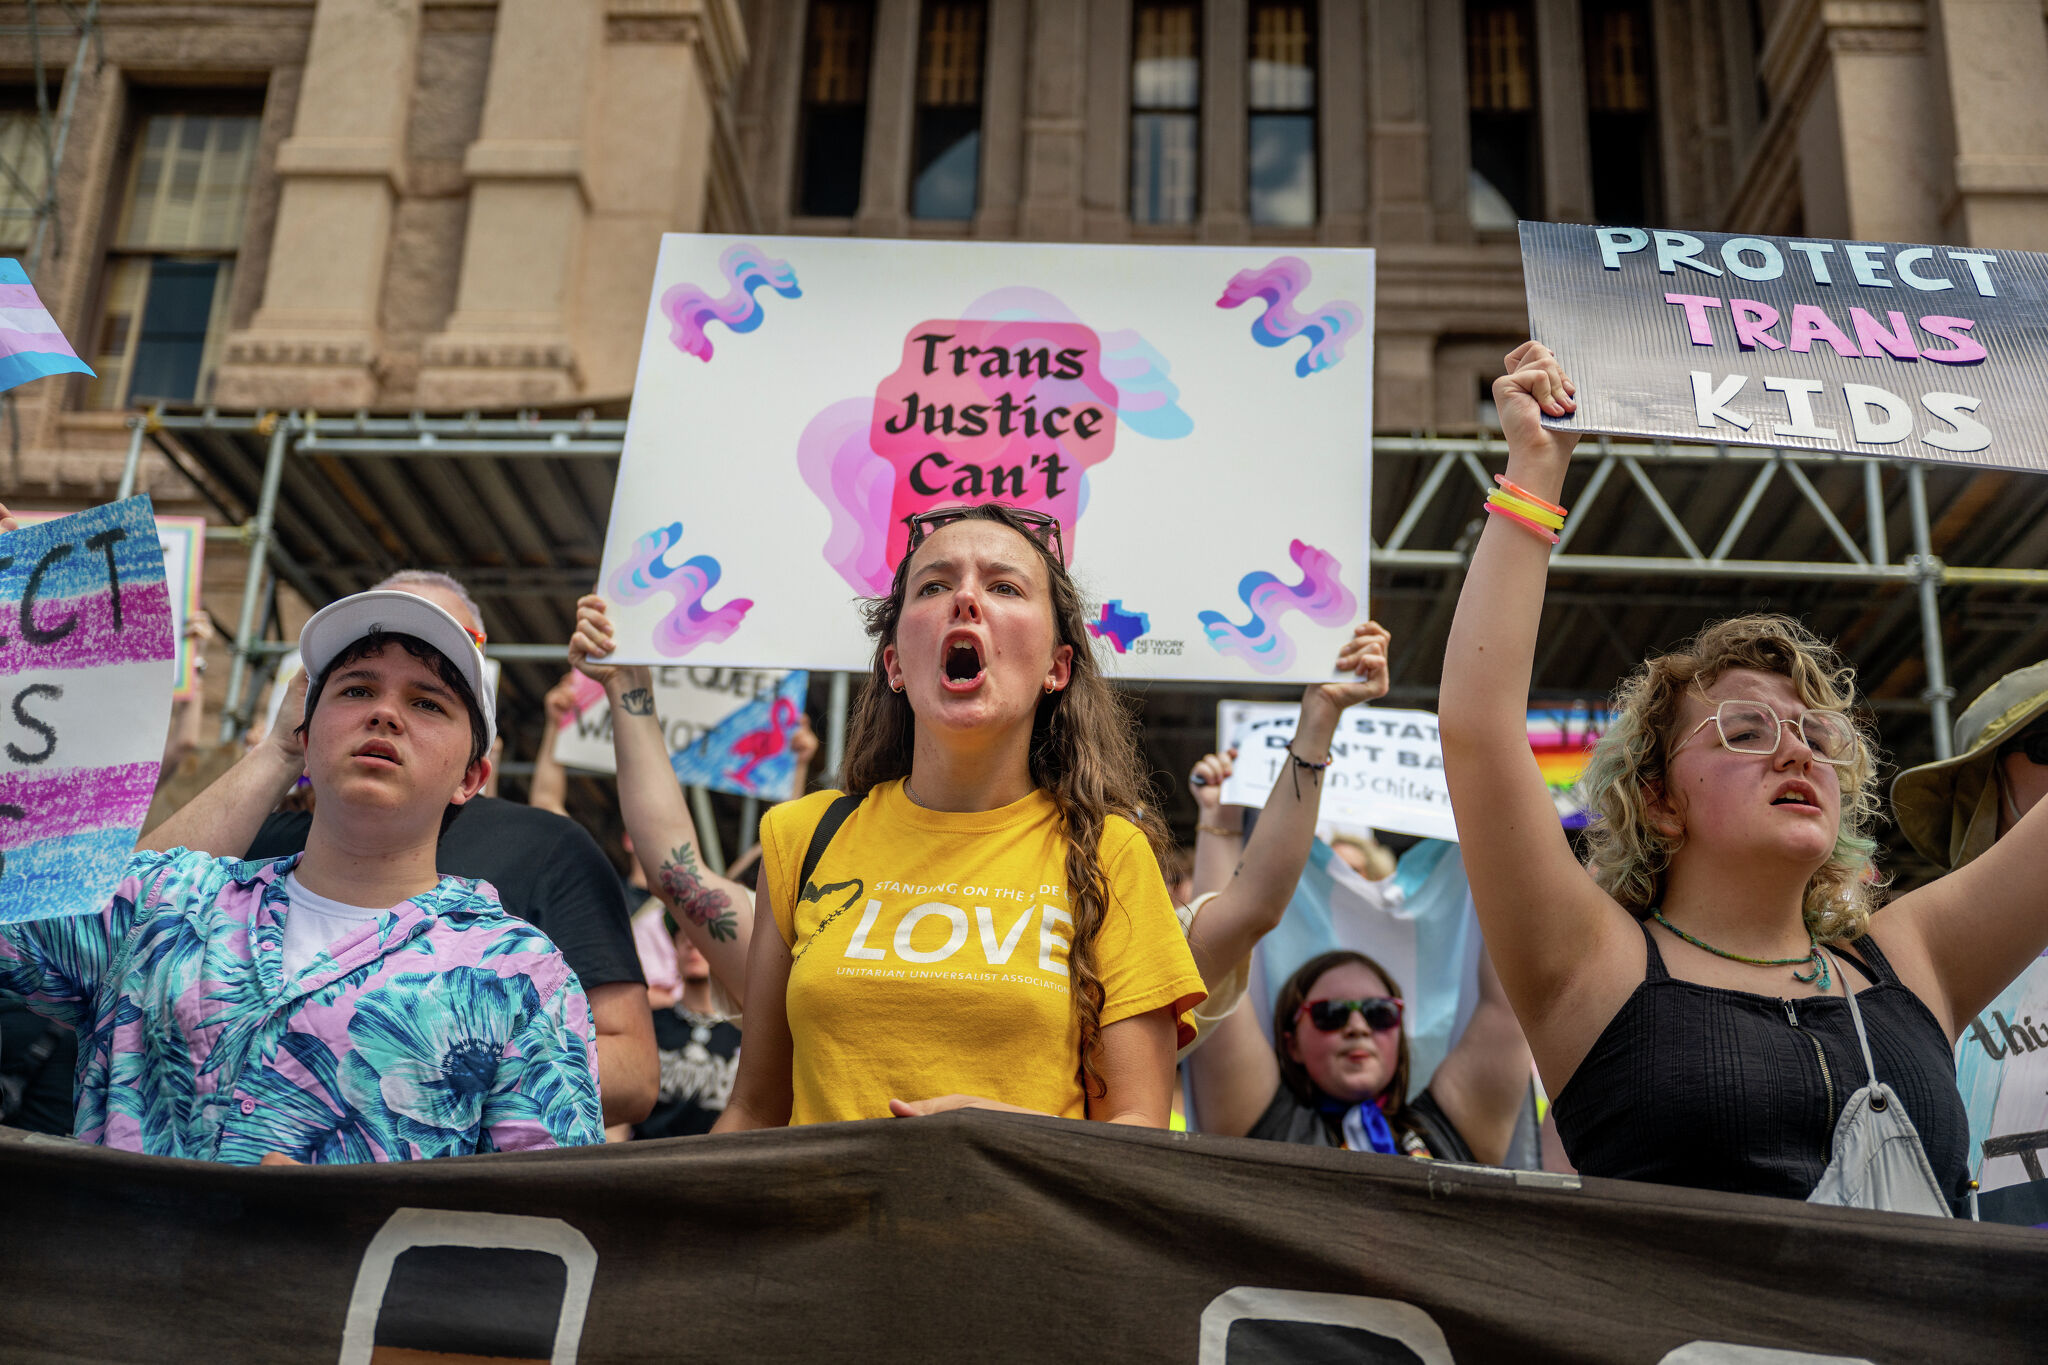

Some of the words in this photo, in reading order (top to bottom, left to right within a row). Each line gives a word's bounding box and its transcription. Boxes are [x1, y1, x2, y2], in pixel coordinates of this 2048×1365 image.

[1595, 228, 1998, 297] PROTECT
[1665, 293, 1988, 364] TRANS
[912, 333, 1088, 380] Trans
[885, 392, 1104, 440] Justice
[1690, 371, 1993, 452] KIDS
[909, 451, 1070, 499] Can't
[1136, 640, 1184, 648] NETWORK
[1266, 735, 1384, 763] DN'T
[873, 880, 959, 895] STANDING
[963, 885, 990, 897] ON
[994, 887, 1025, 902] THE
[1028, 884, 1060, 902] SDE
[843, 898, 1074, 978] LOVE
[836, 966, 906, 978] UNITARIAN
[909, 970, 999, 982] UNIVERSALIST
[1001, 973, 1070, 996] ASSOCIATION
